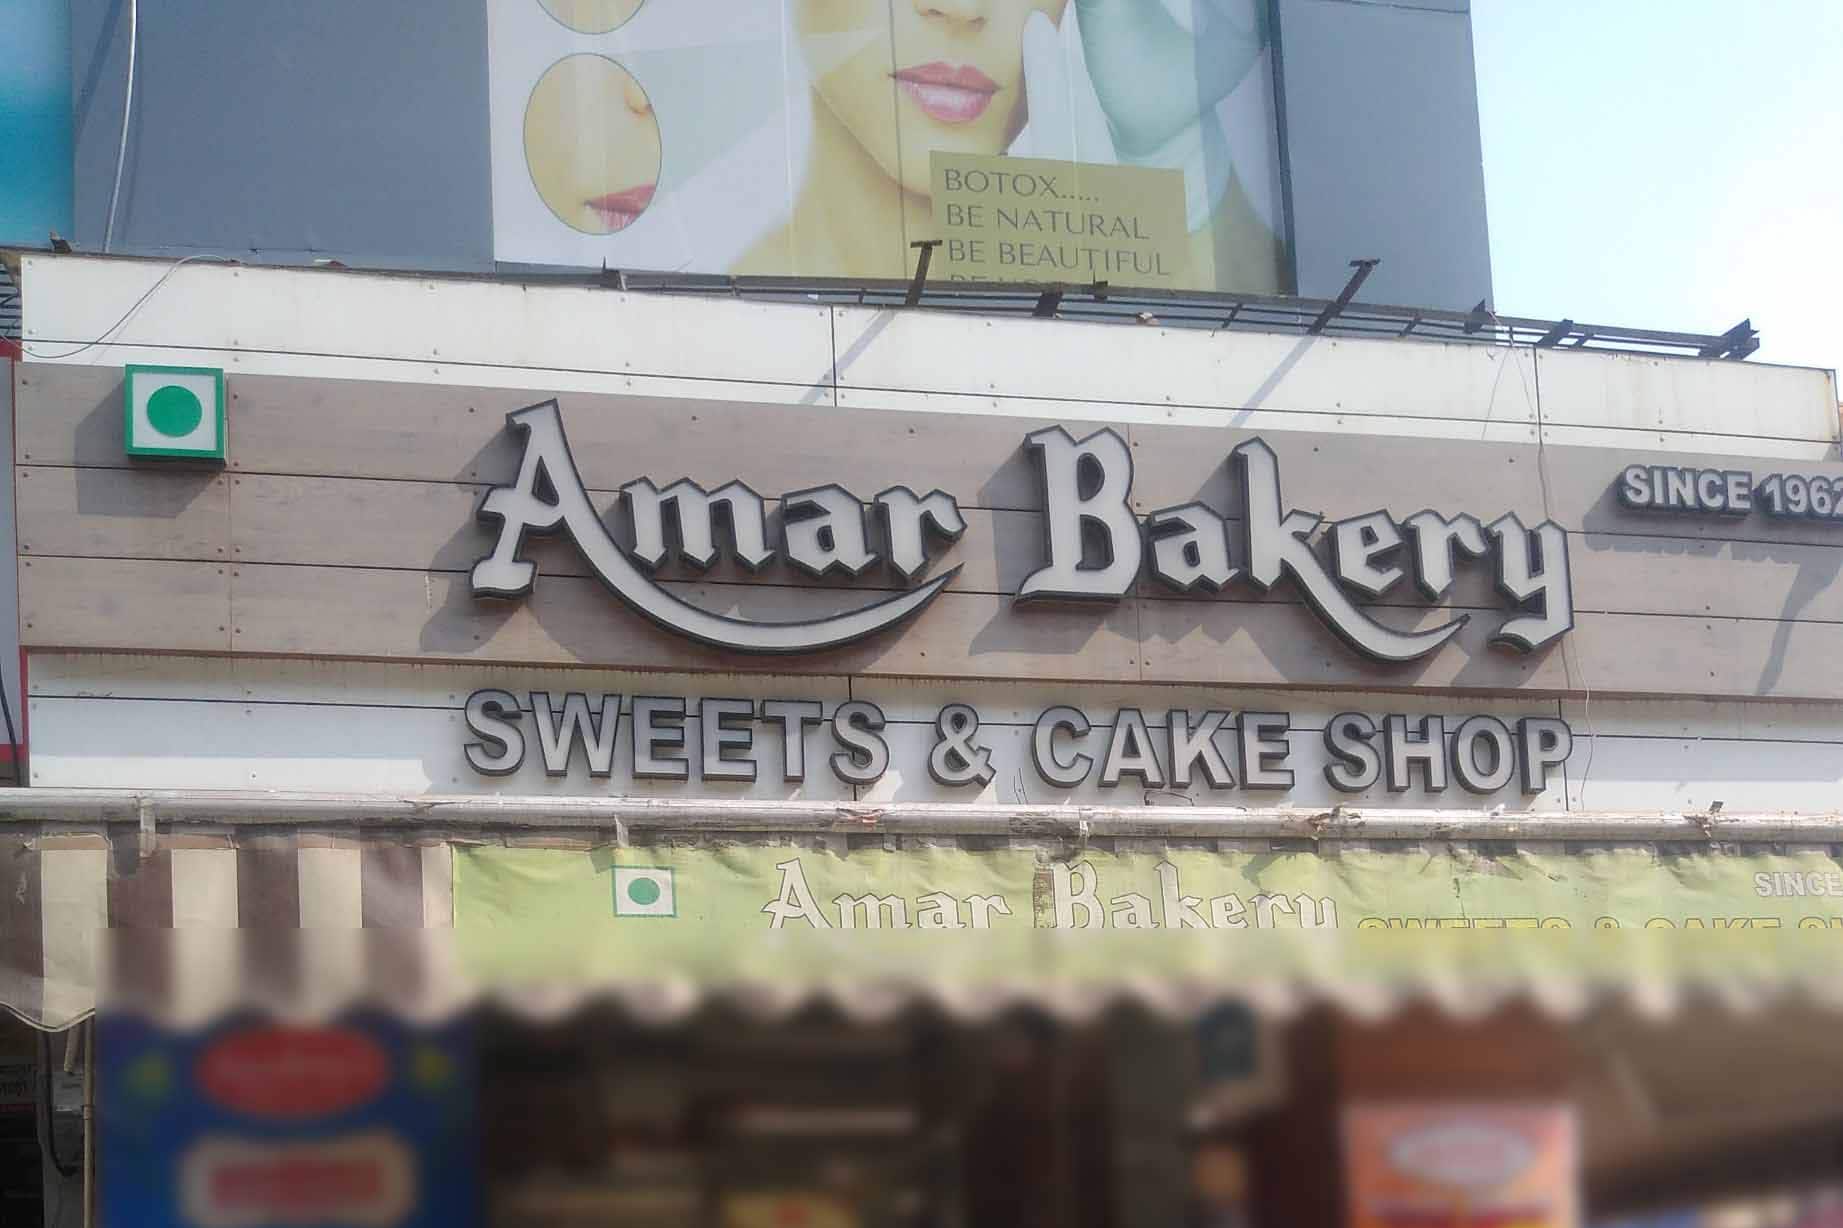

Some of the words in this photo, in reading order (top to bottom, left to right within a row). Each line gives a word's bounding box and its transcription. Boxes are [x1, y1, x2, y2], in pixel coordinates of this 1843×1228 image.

[947, 203, 984, 228] BE
[997, 207, 1151, 240] NATURAL
[949, 239, 985, 263] BE
[999, 242, 1170, 275] BEAUTIFUL
[1618, 464, 1752, 514] SINCE
[470, 398, 967, 655] Amar
[1013, 425, 1574, 663] Bakery
[463, 688, 890, 785] SWEETS
[928, 703, 996, 788] &
[1031, 706, 1296, 791] CAKE
[1323, 711, 1573, 796] SHOP
[760, 857, 1013, 929] Amar
[1753, 871, 1843, 897] SINCE
